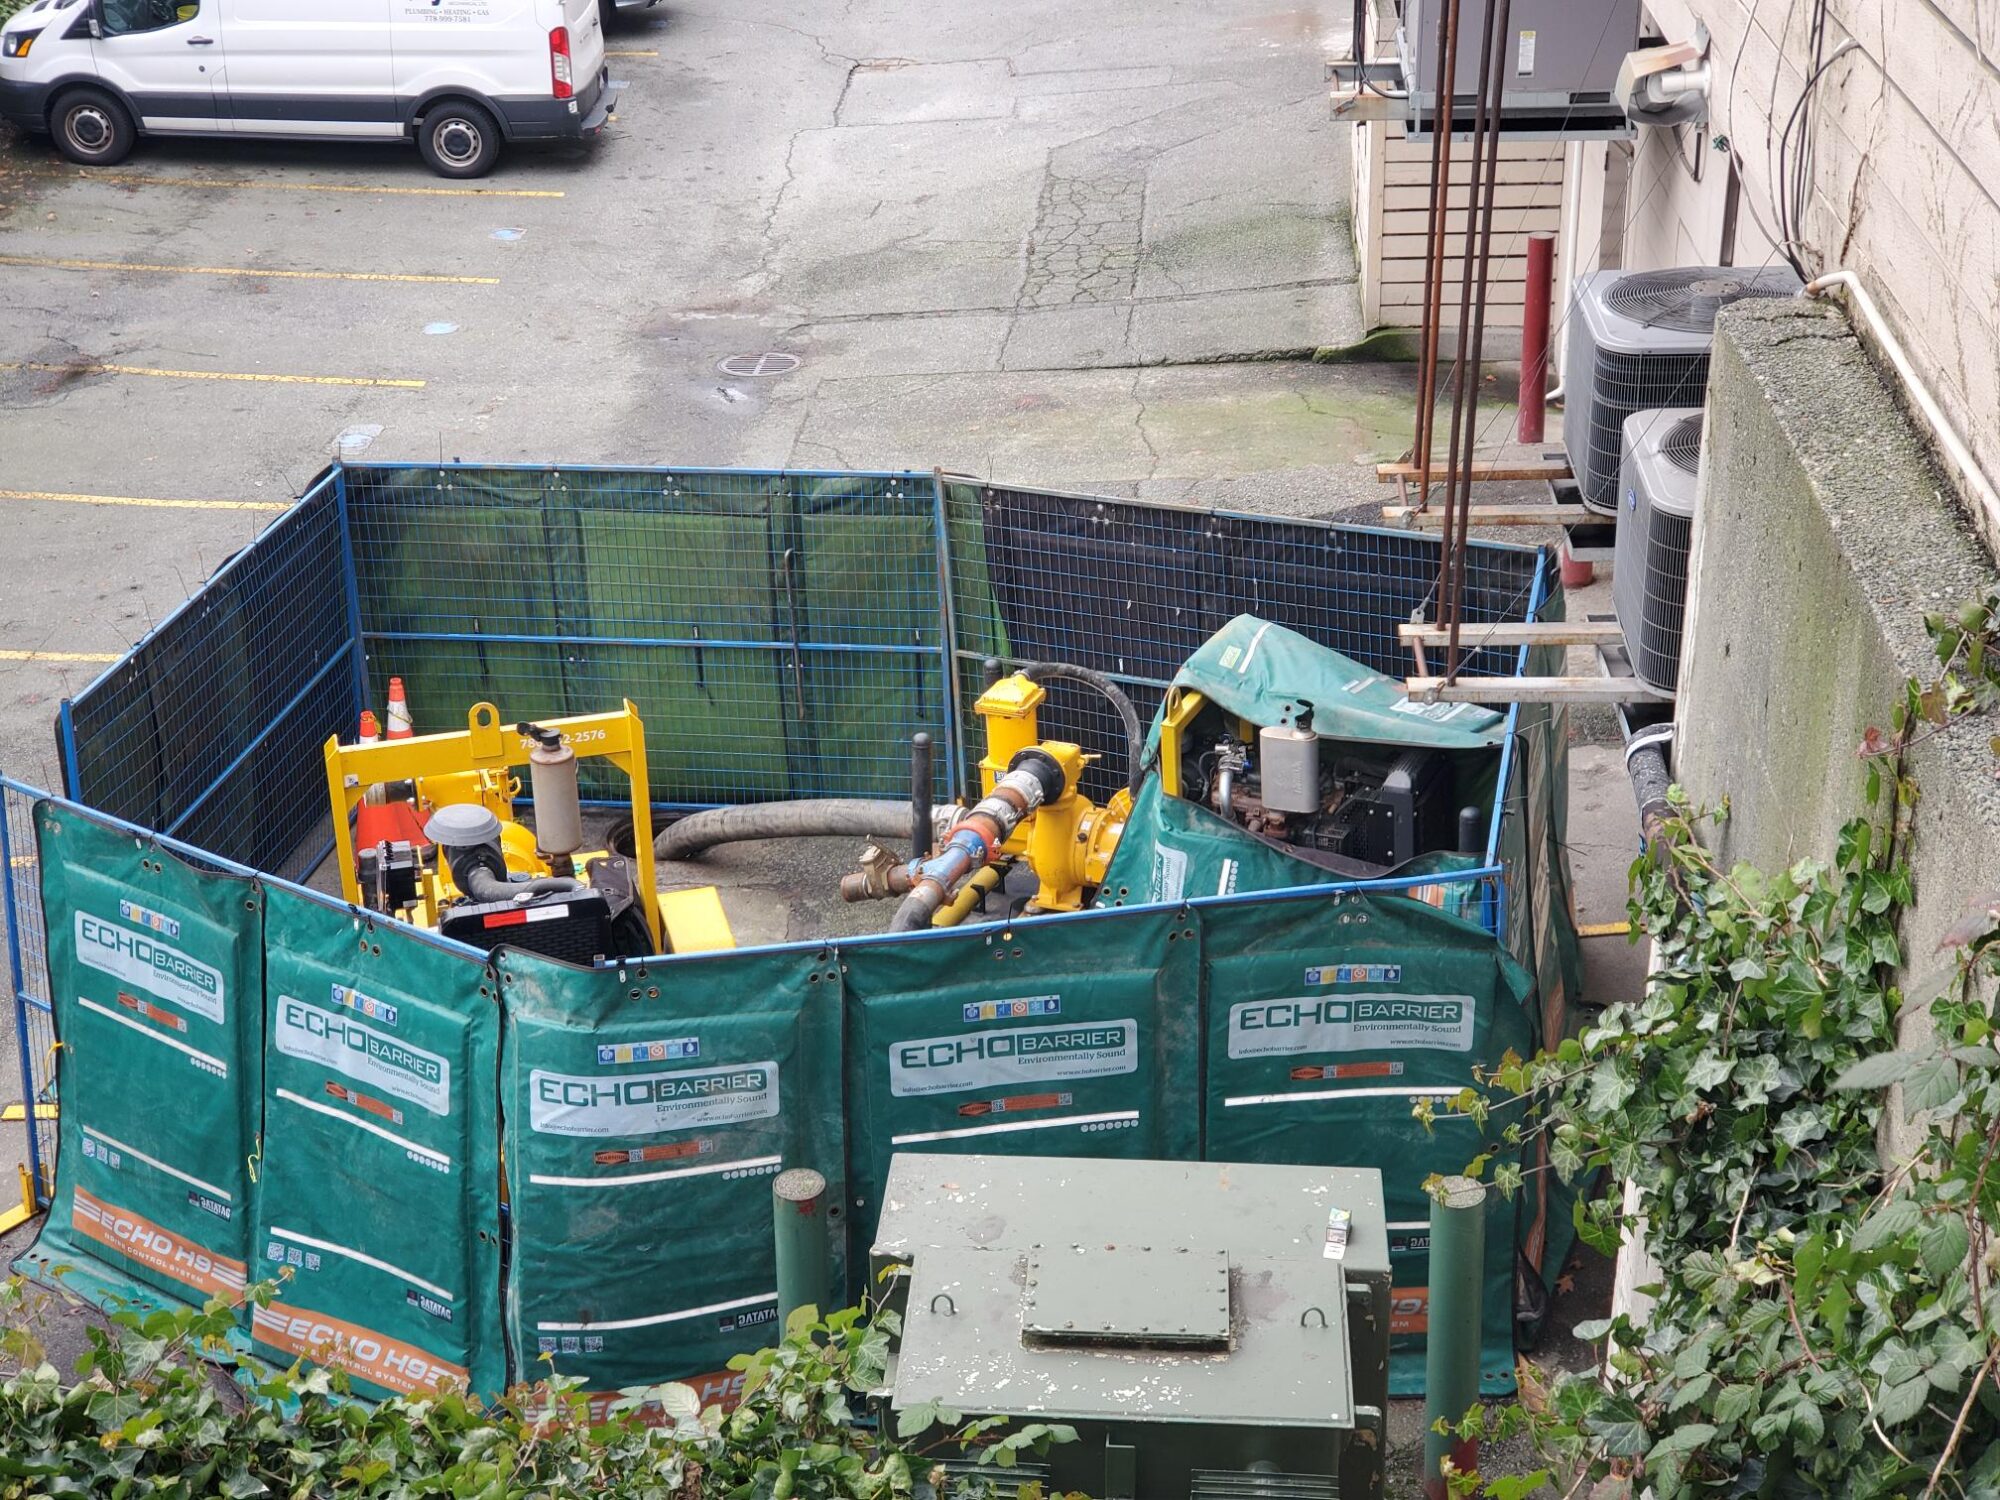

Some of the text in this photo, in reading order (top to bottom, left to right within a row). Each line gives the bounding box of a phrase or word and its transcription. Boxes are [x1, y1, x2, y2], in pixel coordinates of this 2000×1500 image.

[82, 918, 152, 965] ECHO
[155, 952, 215, 990] BARRIER
[1239, 1001, 1458, 1030] ECHO BARRIER
[1353, 1023, 1461, 1034] Environmentally Sound
[286, 1003, 438, 1080] ECHO BARRIER
[901, 1030, 1121, 1069] ECHO BARRIER
[1018, 1048, 1126, 1065] Environmentally Sound
[539, 1073, 762, 1107] ECHO BARRIER
[656, 1092, 767, 1113] Environmentally Sound
[101, 1210, 213, 1274] ECHO H9
[127, 1243, 167, 1267] CONTROL
[169, 1264, 203, 1285] SYSTEM
[738, 1308, 778, 1326] DATATA
[375, 1371, 416, 1391] SYSTEM
[383, 1348, 428, 1381] H9
